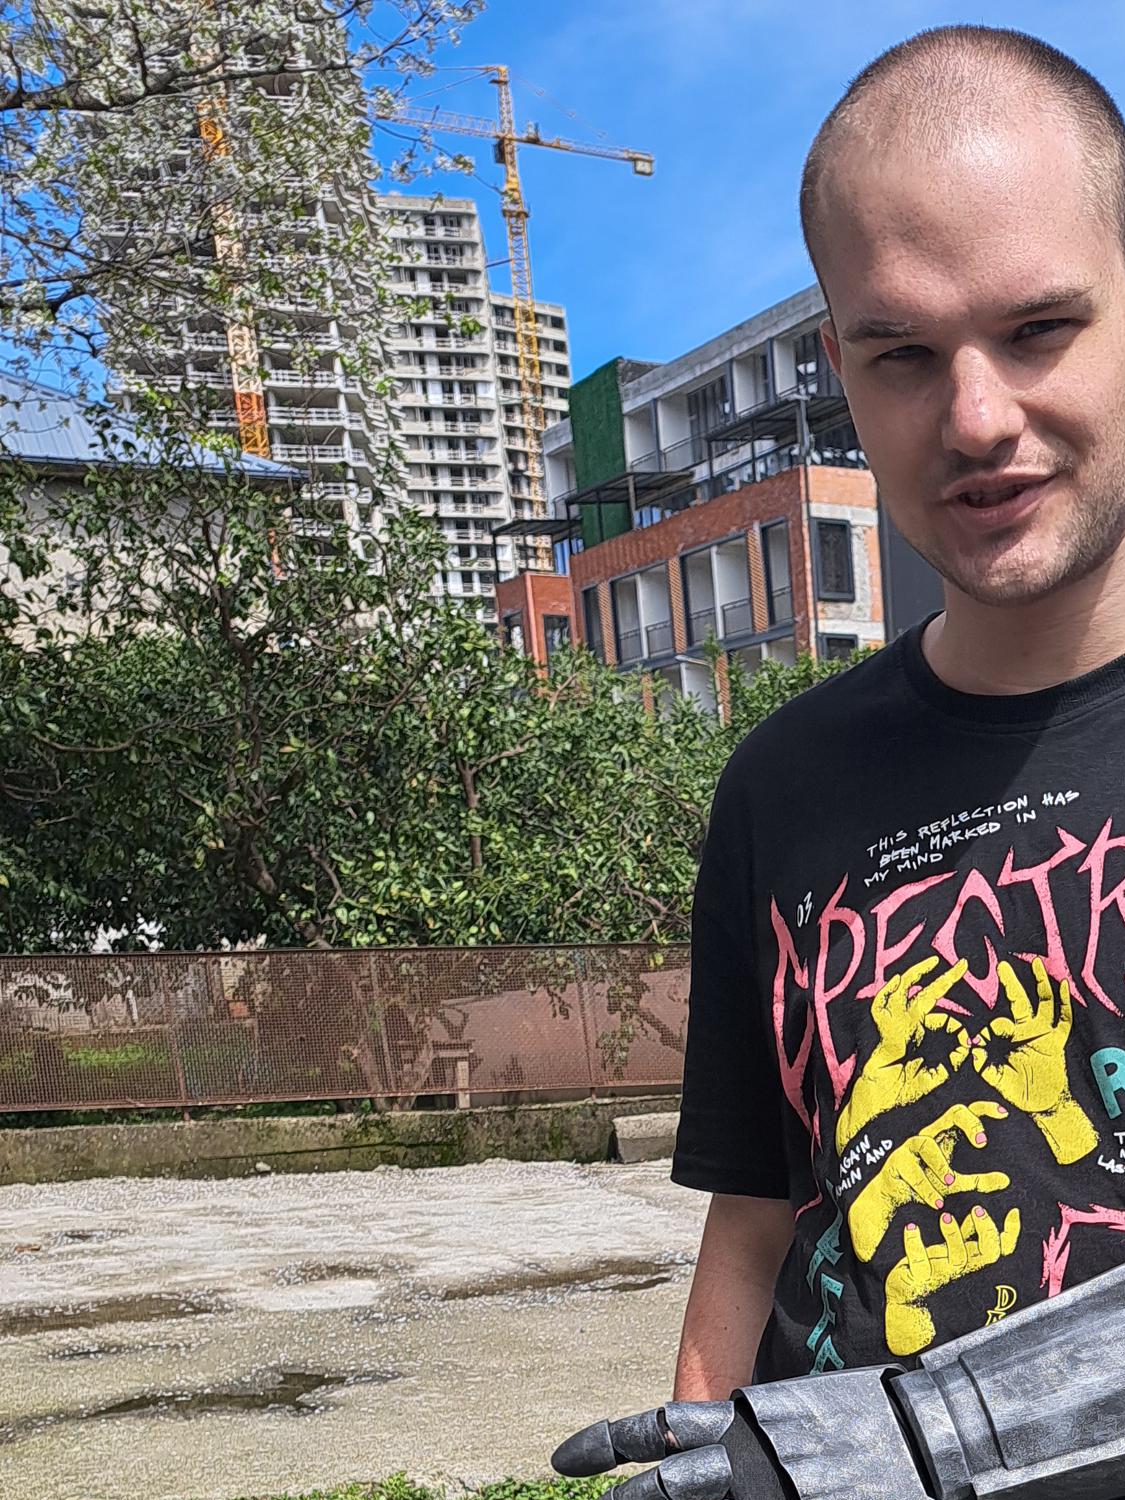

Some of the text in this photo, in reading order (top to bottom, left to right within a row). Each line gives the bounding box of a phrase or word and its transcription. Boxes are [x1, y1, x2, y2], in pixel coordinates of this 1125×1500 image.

[867, 790, 1079, 857] THIS REFLECTION HAS
[879, 810, 1037, 868] BEEN MARKED IN
[864, 852, 943, 887] MY MIND
[839, 1134, 870, 1178] AGAIN
[866, 1139, 893, 1165] AND
